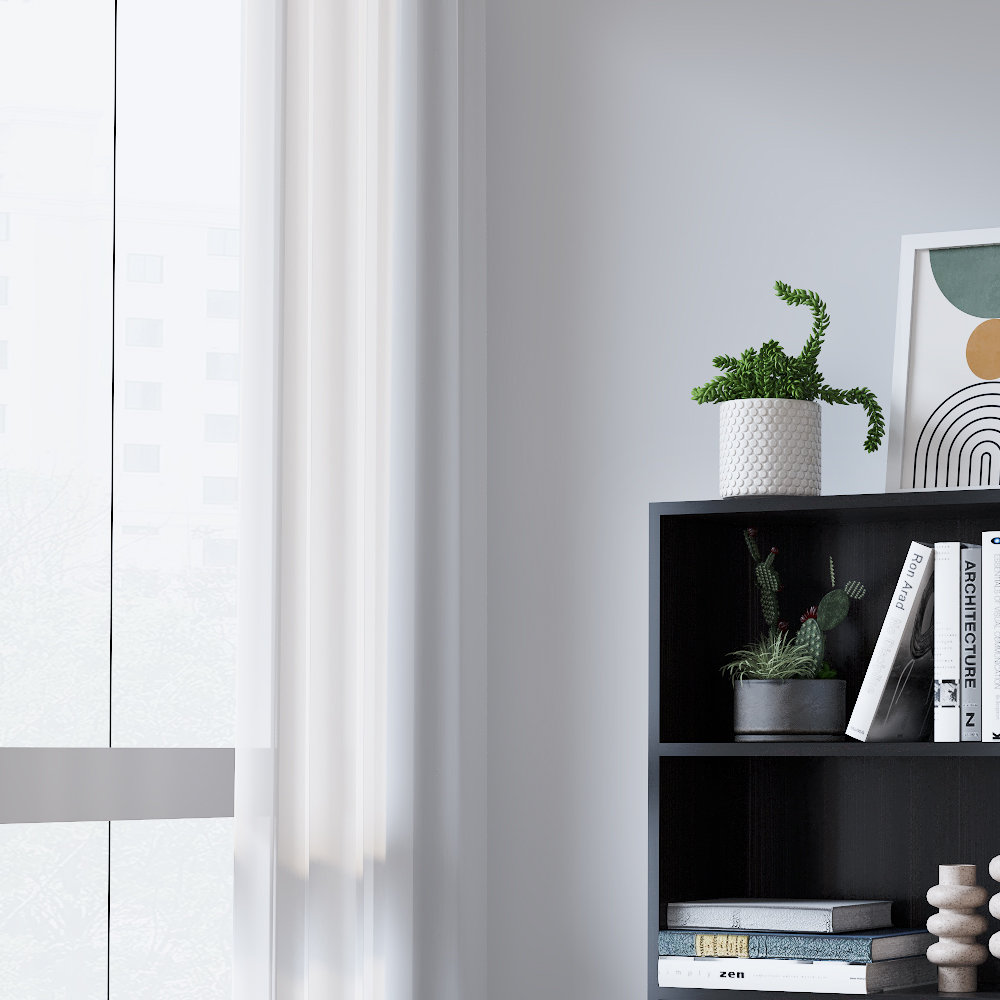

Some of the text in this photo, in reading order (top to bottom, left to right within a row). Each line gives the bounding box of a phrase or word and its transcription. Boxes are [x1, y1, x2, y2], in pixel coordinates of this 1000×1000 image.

[894, 552, 924, 612] Ron Arad
[964, 559, 977, 690] ARCHITECTURE
[719, 970, 745, 979] zen
